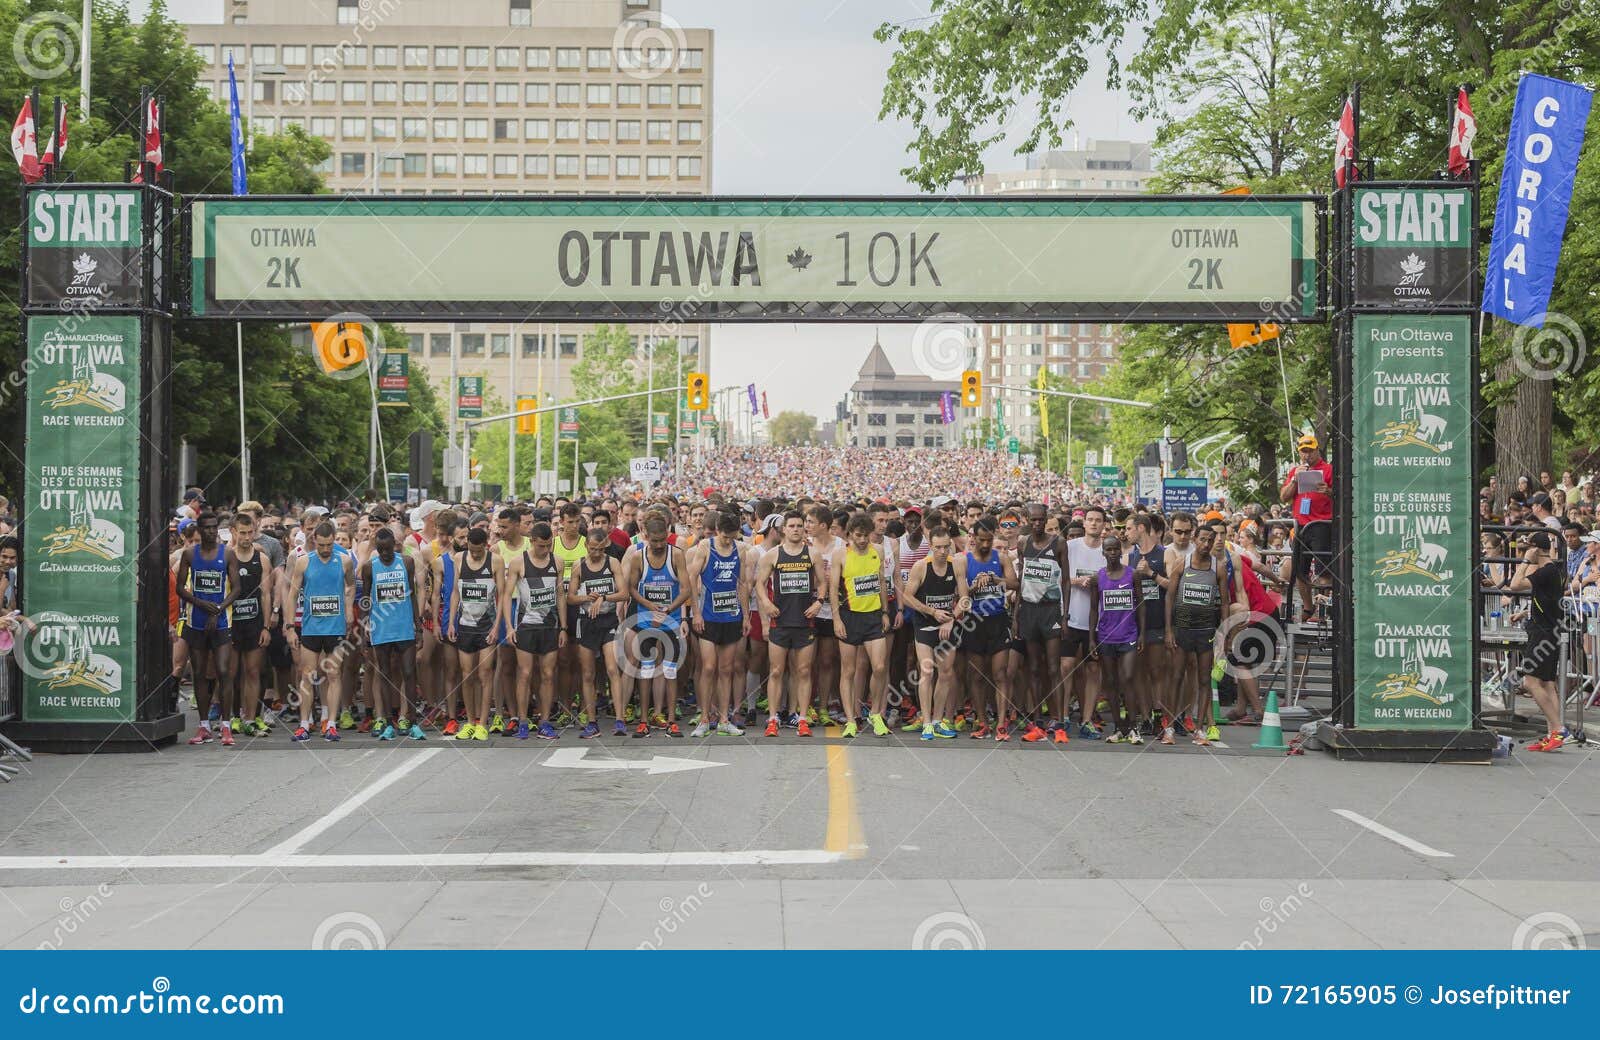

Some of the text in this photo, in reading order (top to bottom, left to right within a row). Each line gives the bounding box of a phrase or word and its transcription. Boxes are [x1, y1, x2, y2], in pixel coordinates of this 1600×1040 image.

[1503, 96, 1560, 310] CORRAL
[34, 193, 135, 242] START
[1360, 191, 1465, 242] START
[251, 228, 317, 248] OTTAWA
[1171, 229, 1239, 248] OTTAWA
[557, 230, 942, 288] OTTAWA 10K
[267, 257, 301, 288] 2K
[1187, 258, 1224, 290] 2K
[71, 272, 95, 285] 2017
[1399, 273, 1424, 285] 2017
[66, 286, 103, 295] OTTAWA
[1393, 287, 1432, 296] OTTAWA
[1371, 328, 1453, 342] Run Ottawa
[1381, 345, 1444, 361] presents
[43, 415, 124, 426] RACE WEEKEND
[635, 460, 659, 471] 0:42
[1374, 456, 1451, 466] RACE WEEKEND
[41, 466, 123, 476] FIN DE SEMAINE
[41, 477, 123, 488] DES COURSES
[1374, 492, 1452, 502] FIN DE SEMAINE
[1374, 503, 1452, 512] DES COURSES
[1024, 568, 1051, 577] CHEPROT
[201, 578, 216, 586] TOLA
[781, 579, 809, 587] WINSLOW
[380, 589, 401, 597] MAIYO
[466, 589, 482, 597] ZIANI
[589, 585, 609, 594] TAMRI
[1374, 583, 1451, 596] TAMARACK
[1105, 596, 1131, 604] LOTIANG
[312, 602, 338, 610] FRIESEN
[1374, 622, 1451, 636] TAMARACK
[39, 696, 121, 707] RACE WEEKEND
[1374, 708, 1452, 718] RACE WEEKEND
